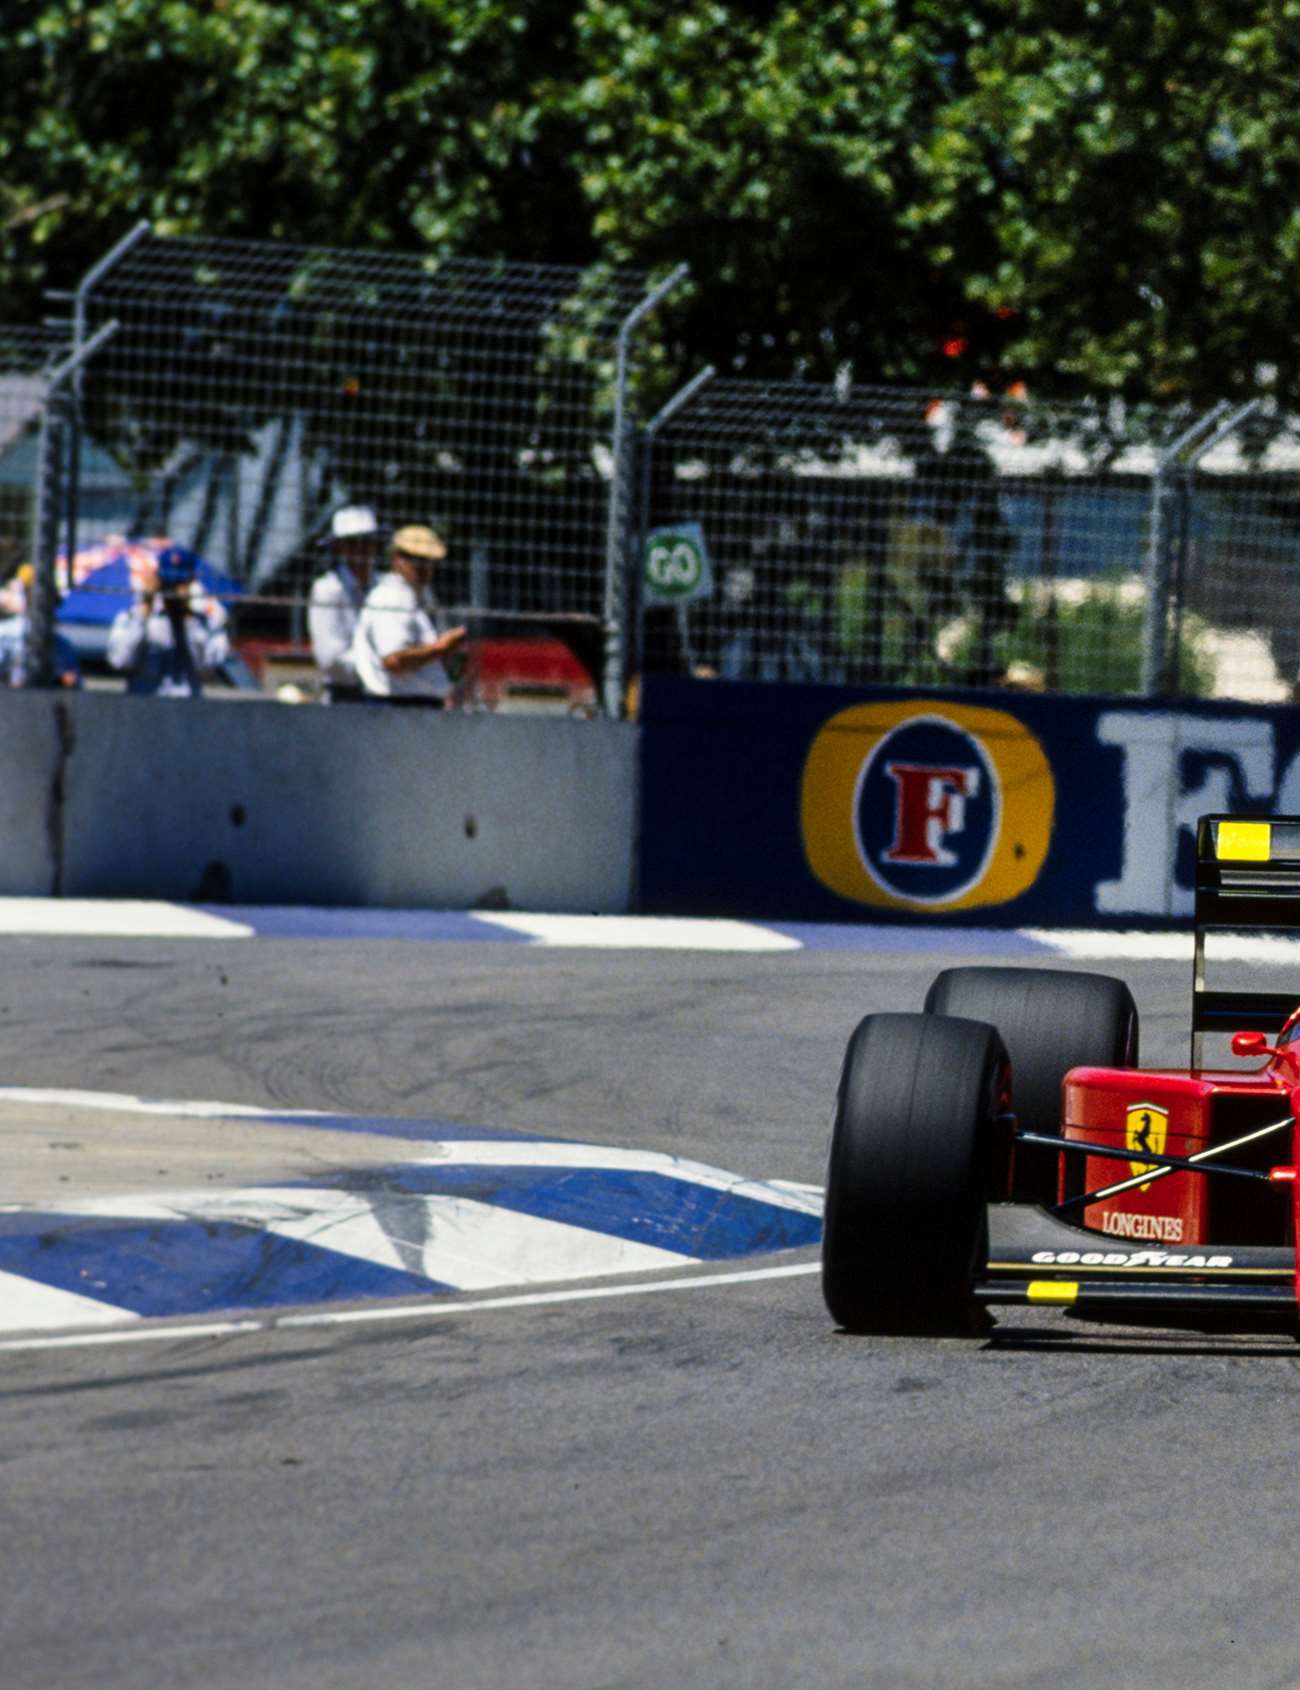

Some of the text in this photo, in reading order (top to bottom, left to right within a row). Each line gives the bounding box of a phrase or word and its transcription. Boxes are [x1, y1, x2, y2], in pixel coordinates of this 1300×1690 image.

[650, 543, 697, 586] GO
[884, 764, 980, 865] F
[1102, 1211, 1184, 1241] LONGINES
[1031, 1251, 1233, 1267] GOODYEAR
